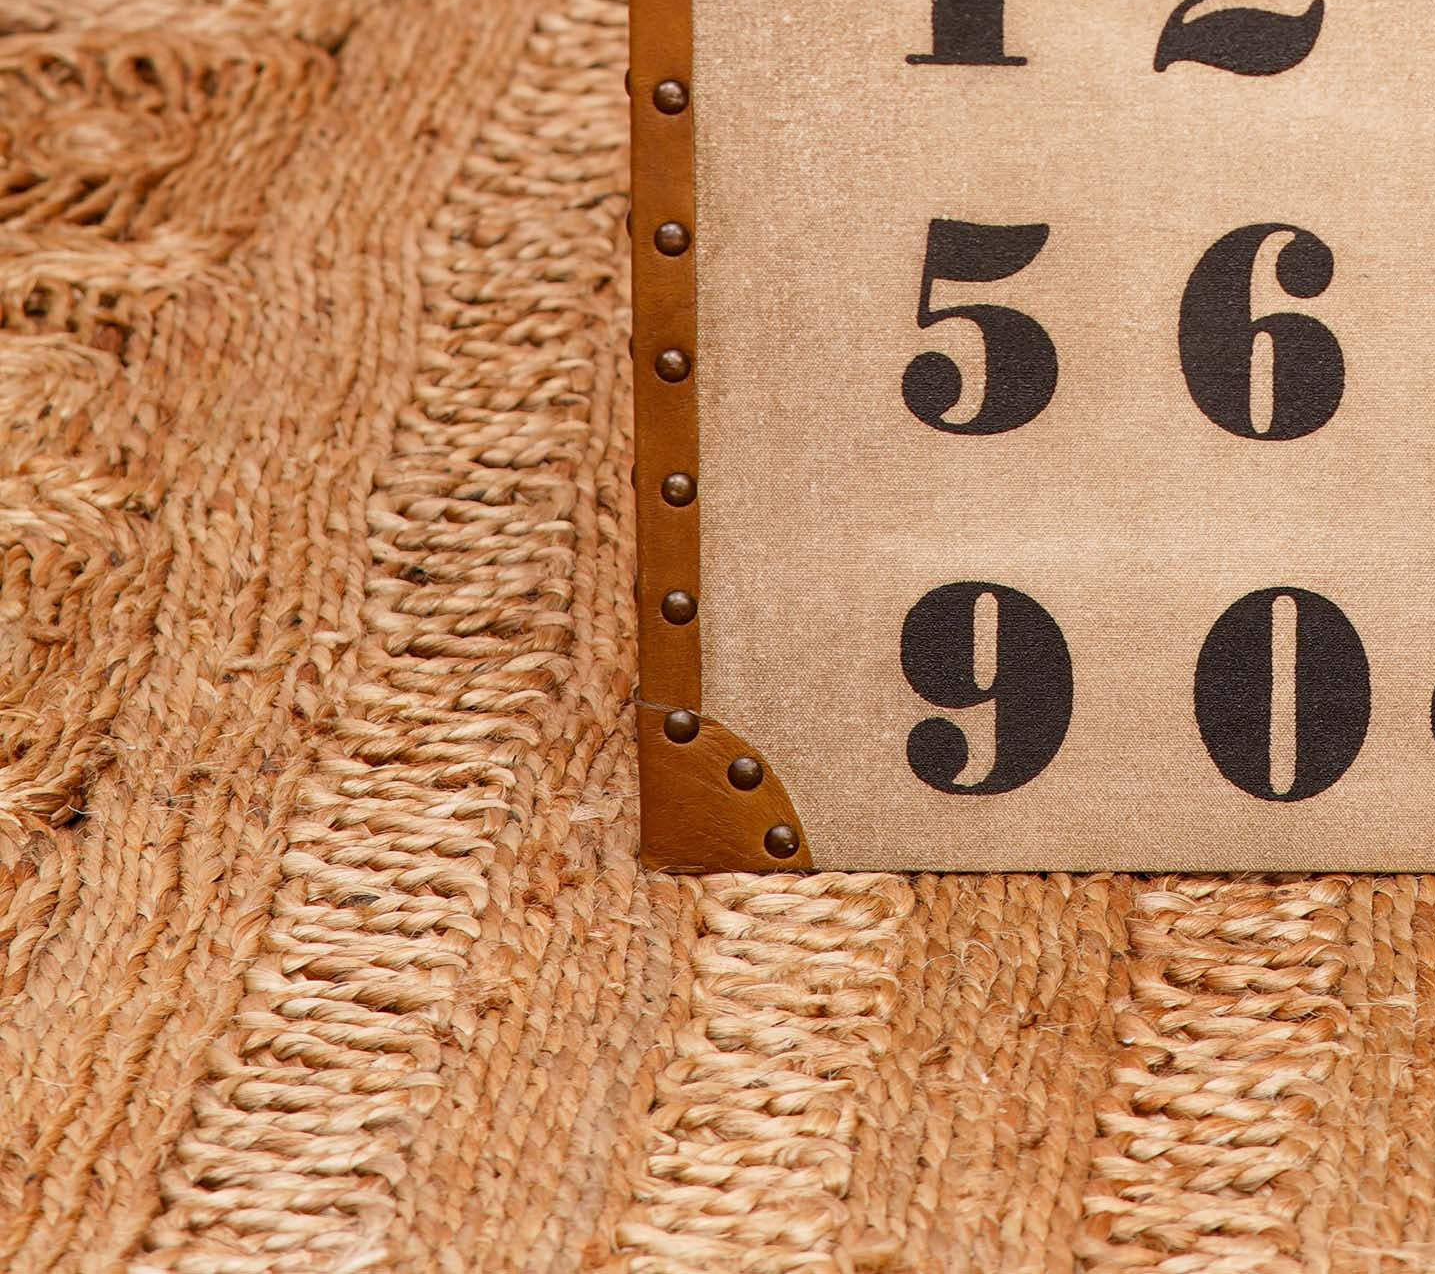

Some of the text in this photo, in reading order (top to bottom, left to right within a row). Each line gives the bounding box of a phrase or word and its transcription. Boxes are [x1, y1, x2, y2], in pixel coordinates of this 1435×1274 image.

[901, 218, 1059, 436] 5
[1178, 222, 1345, 442] 6
[896, 581, 1074, 797] 9
[1192, 586, 1374, 803] 0
